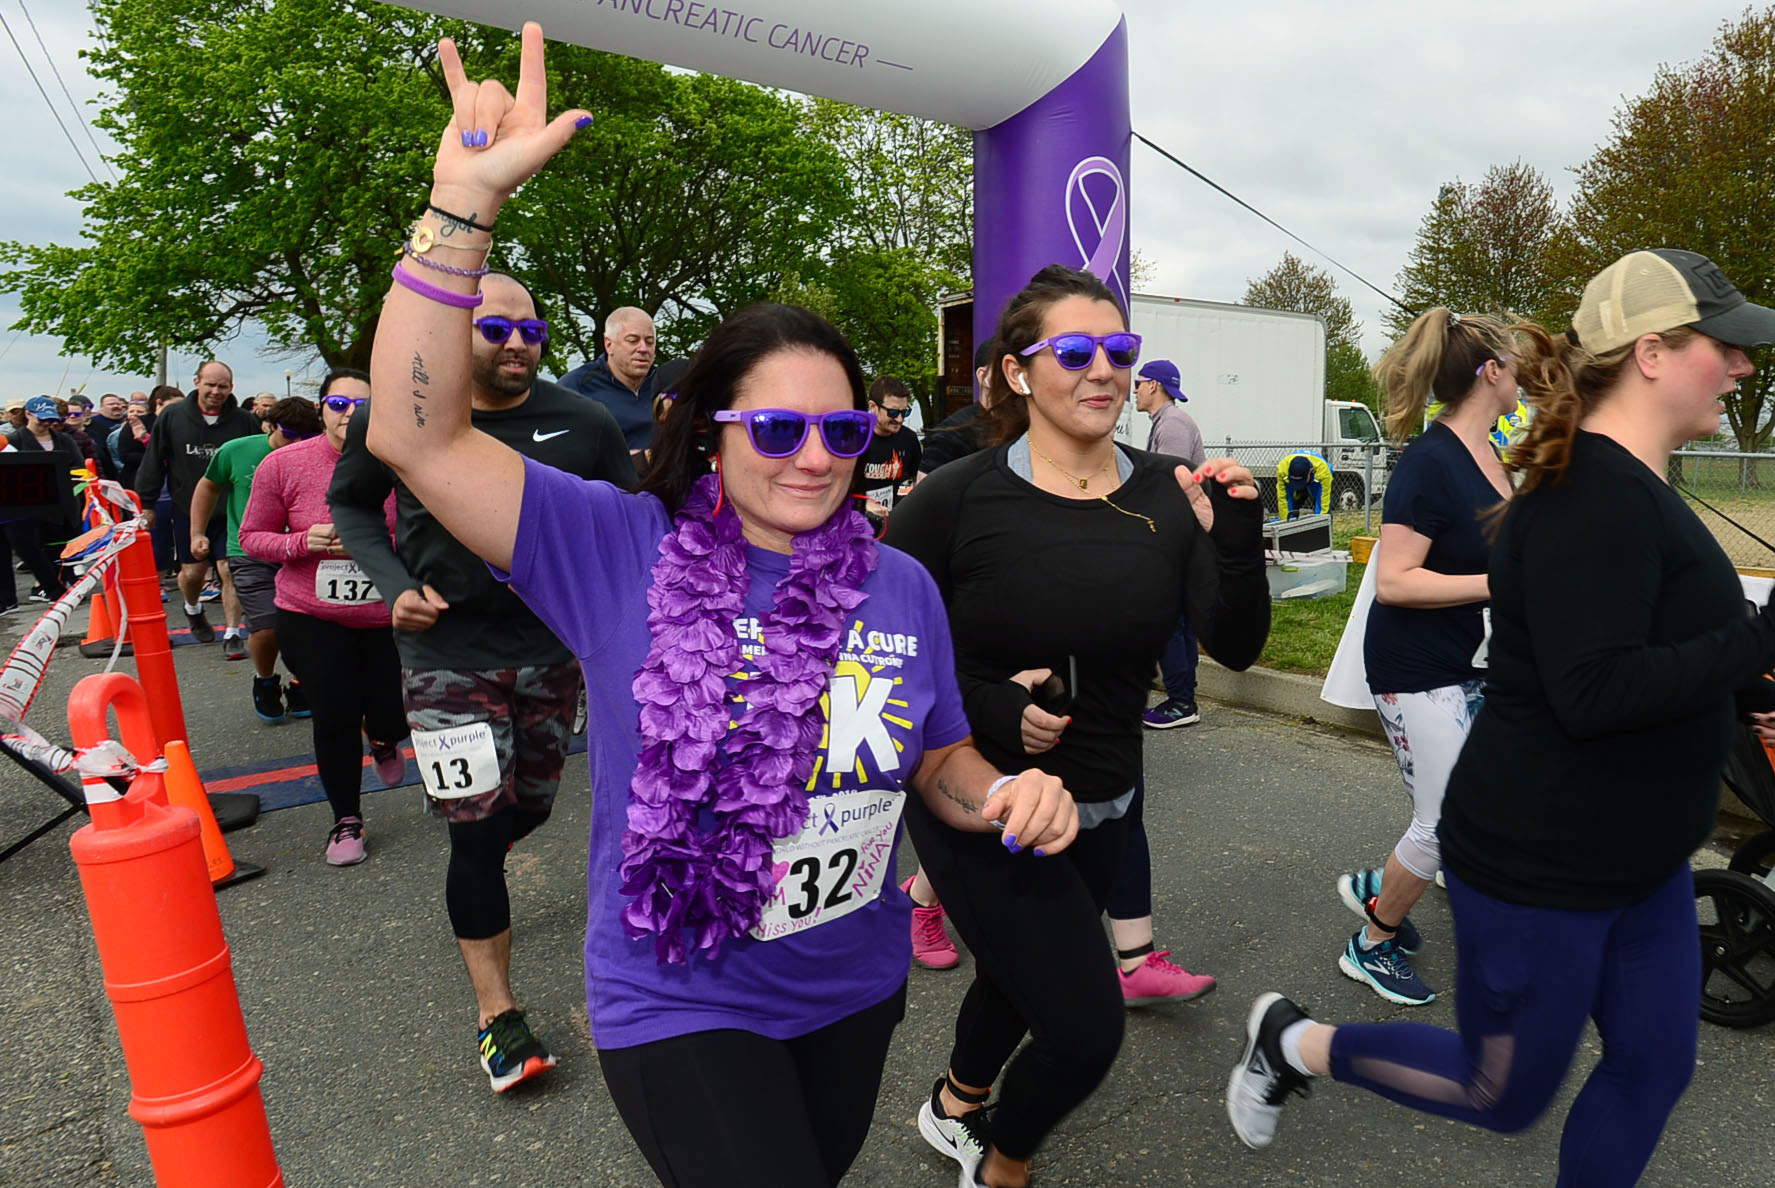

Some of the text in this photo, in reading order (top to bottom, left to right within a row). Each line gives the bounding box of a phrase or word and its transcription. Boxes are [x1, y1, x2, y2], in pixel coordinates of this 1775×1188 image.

[597, 0, 869, 68] NCREATIC CANCER
[328, 579, 374, 601] 137
[867, 630, 918, 657] CURE
[450, 730, 486, 746] purple
[432, 758, 473, 790] 13
[841, 798, 893, 827] purple
[788, 848, 858, 919] 32
